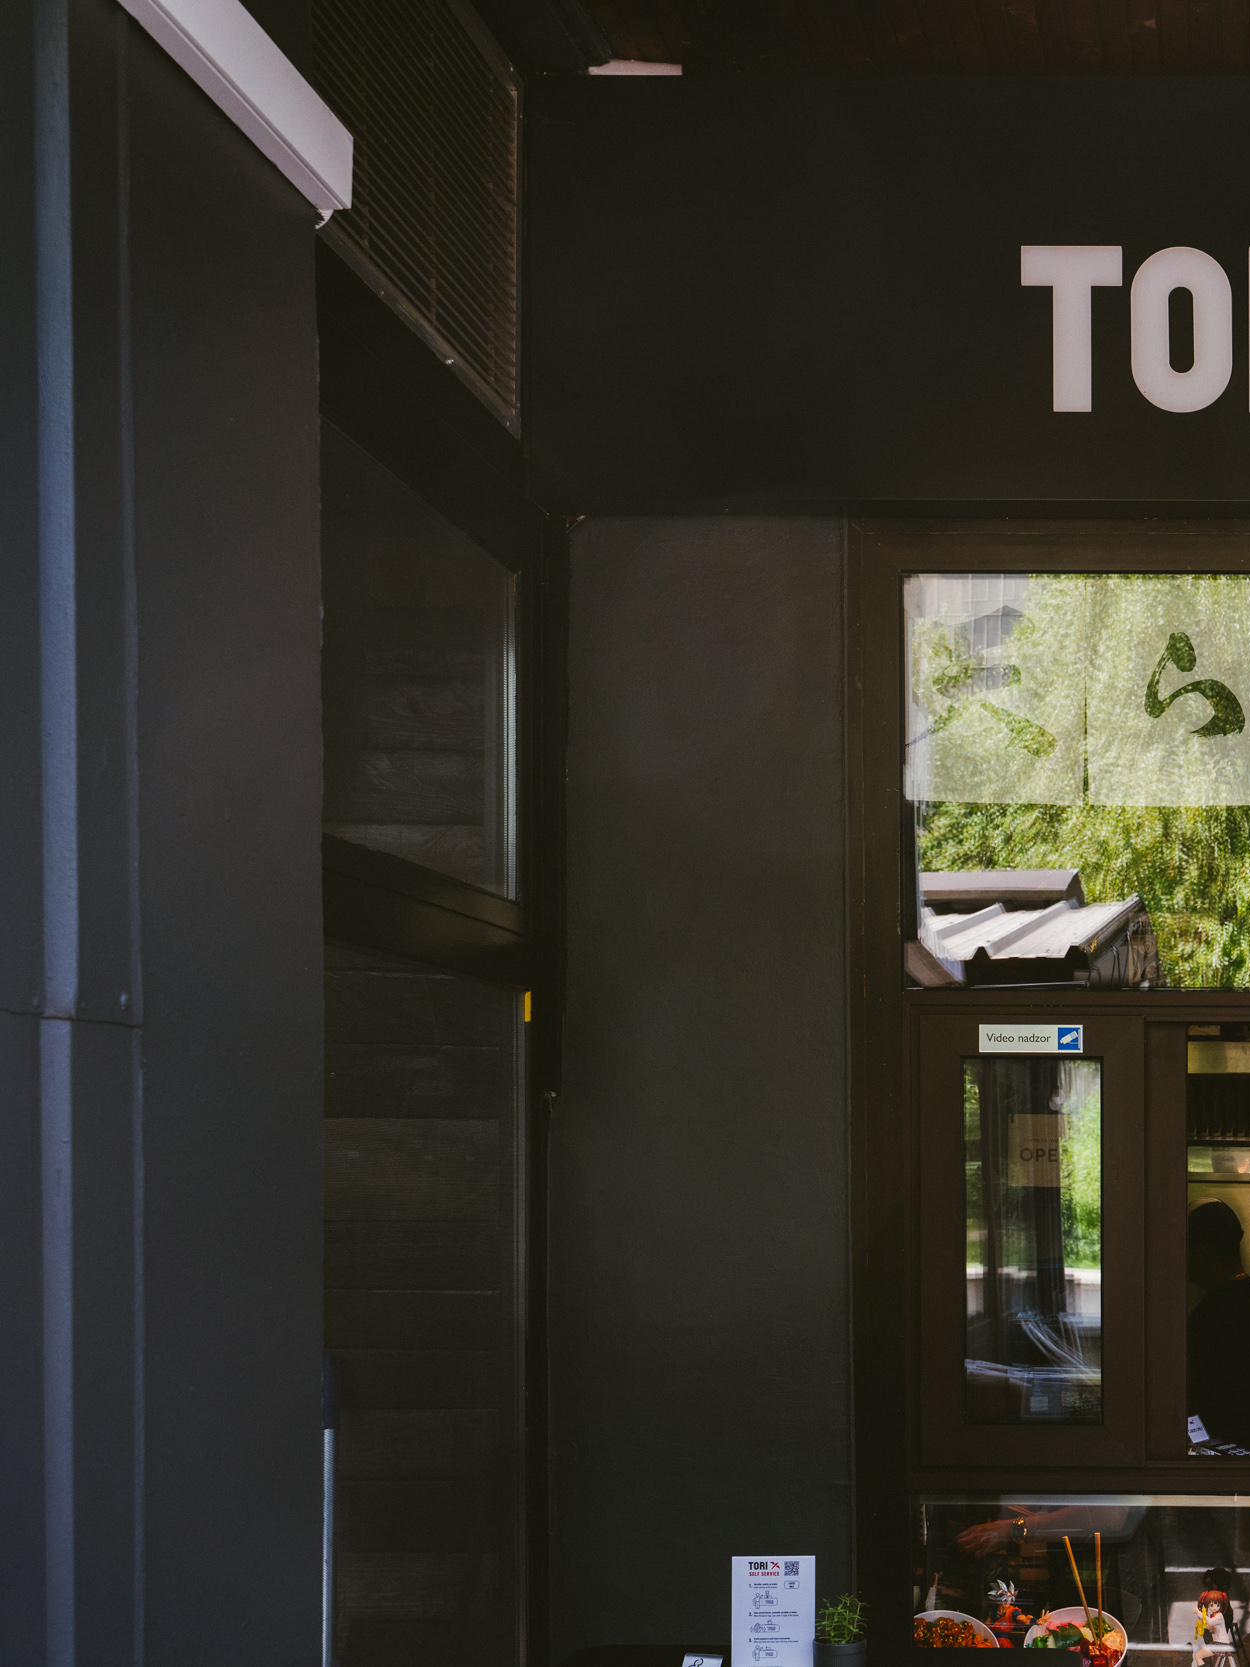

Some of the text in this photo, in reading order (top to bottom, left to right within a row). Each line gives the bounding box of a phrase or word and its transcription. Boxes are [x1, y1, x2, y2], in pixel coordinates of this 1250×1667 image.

[986, 1033, 1051, 1042] Video nadzor
[748, 1562, 768, 1570] TORI
